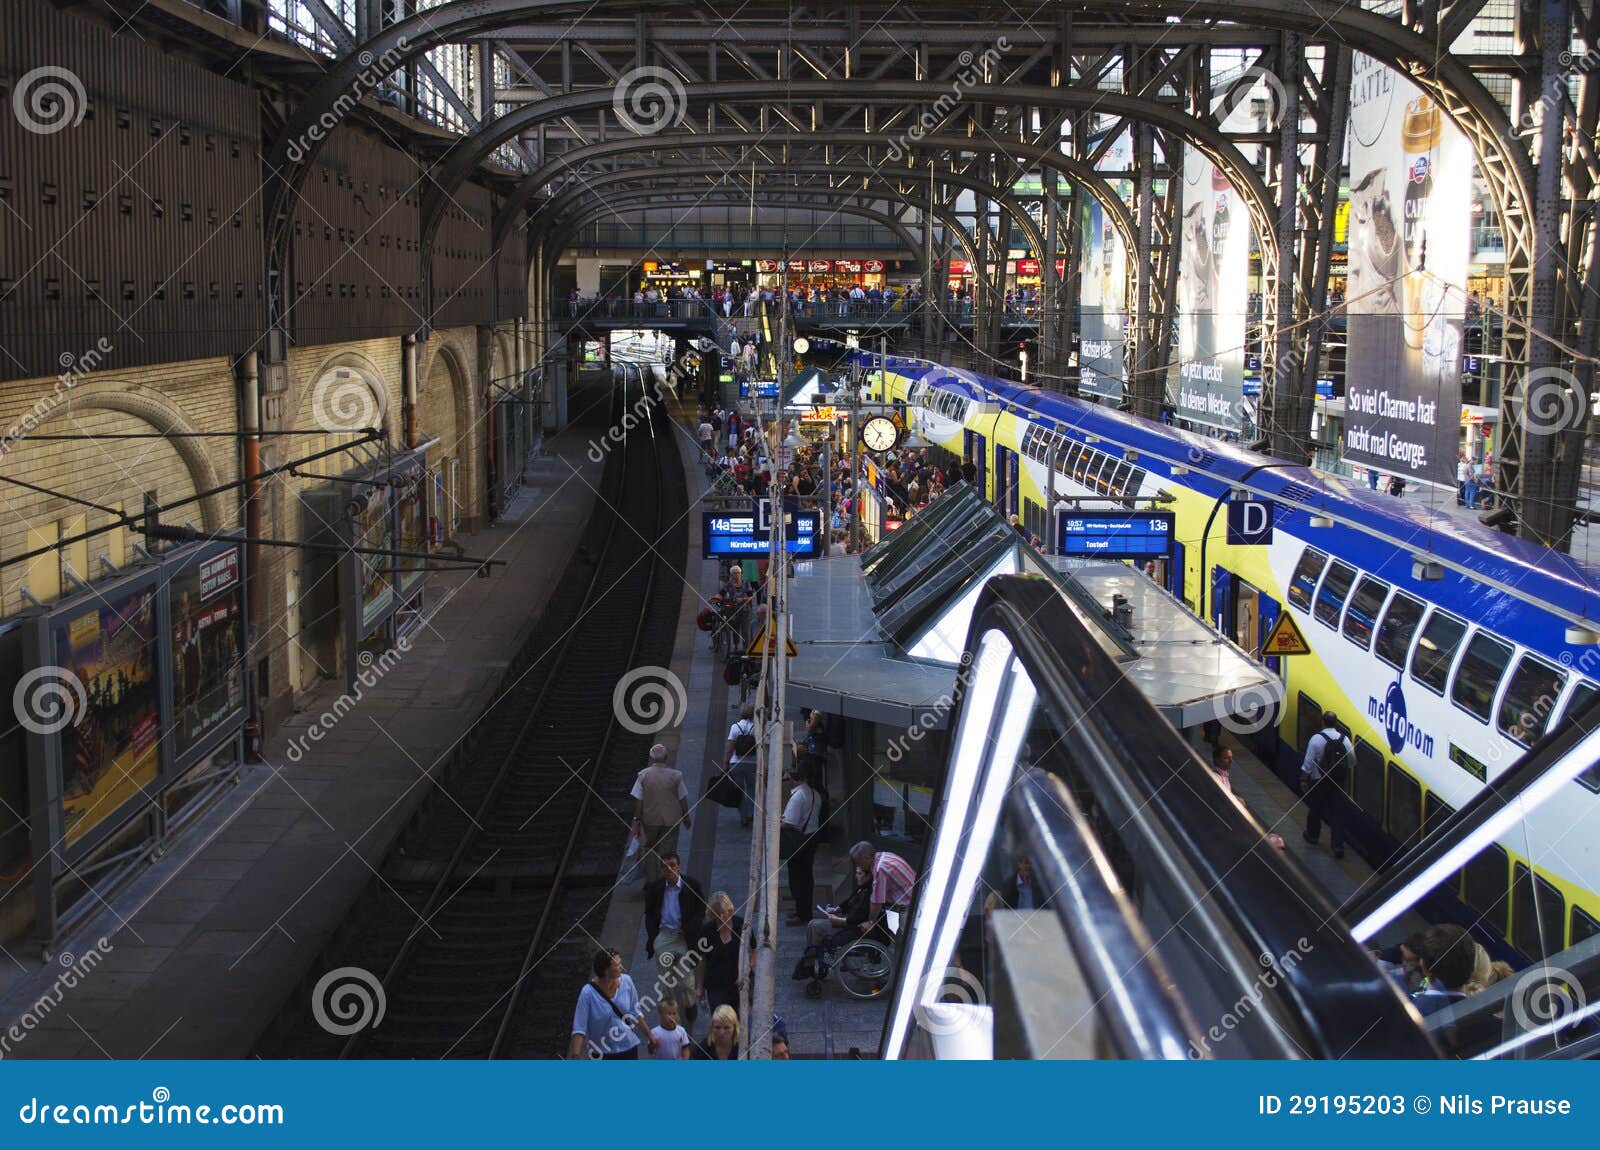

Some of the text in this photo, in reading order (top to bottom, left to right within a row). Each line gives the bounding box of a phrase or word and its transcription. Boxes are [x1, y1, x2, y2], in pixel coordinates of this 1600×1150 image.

[1353, 66, 1390, 108] LATTE
[721, 356, 728, 367] E
[1249, 358, 1257, 368] E
[1469, 358, 1477, 370] E
[1188, 360, 1202, 382] jetzt
[1202, 359, 1223, 383] weckst
[1188, 388, 1207, 412] deinen
[1207, 392, 1231, 417] Wecker.
[1349, 386, 1360, 412] So
[1362, 388, 1377, 416] viel
[1378, 390, 1415, 422] Charme
[1417, 395, 1436, 425] hat
[1347, 425, 1428, 469] nicht mal George.
[710, 519, 730, 531] 14a
[797, 519, 813, 527] 19:01
[1149, 519, 1168, 531] 13a
[1243, 502, 1268, 535] D
[730, 541, 757, 549] Nürnberg
[1368, 694, 1434, 759] metronom
